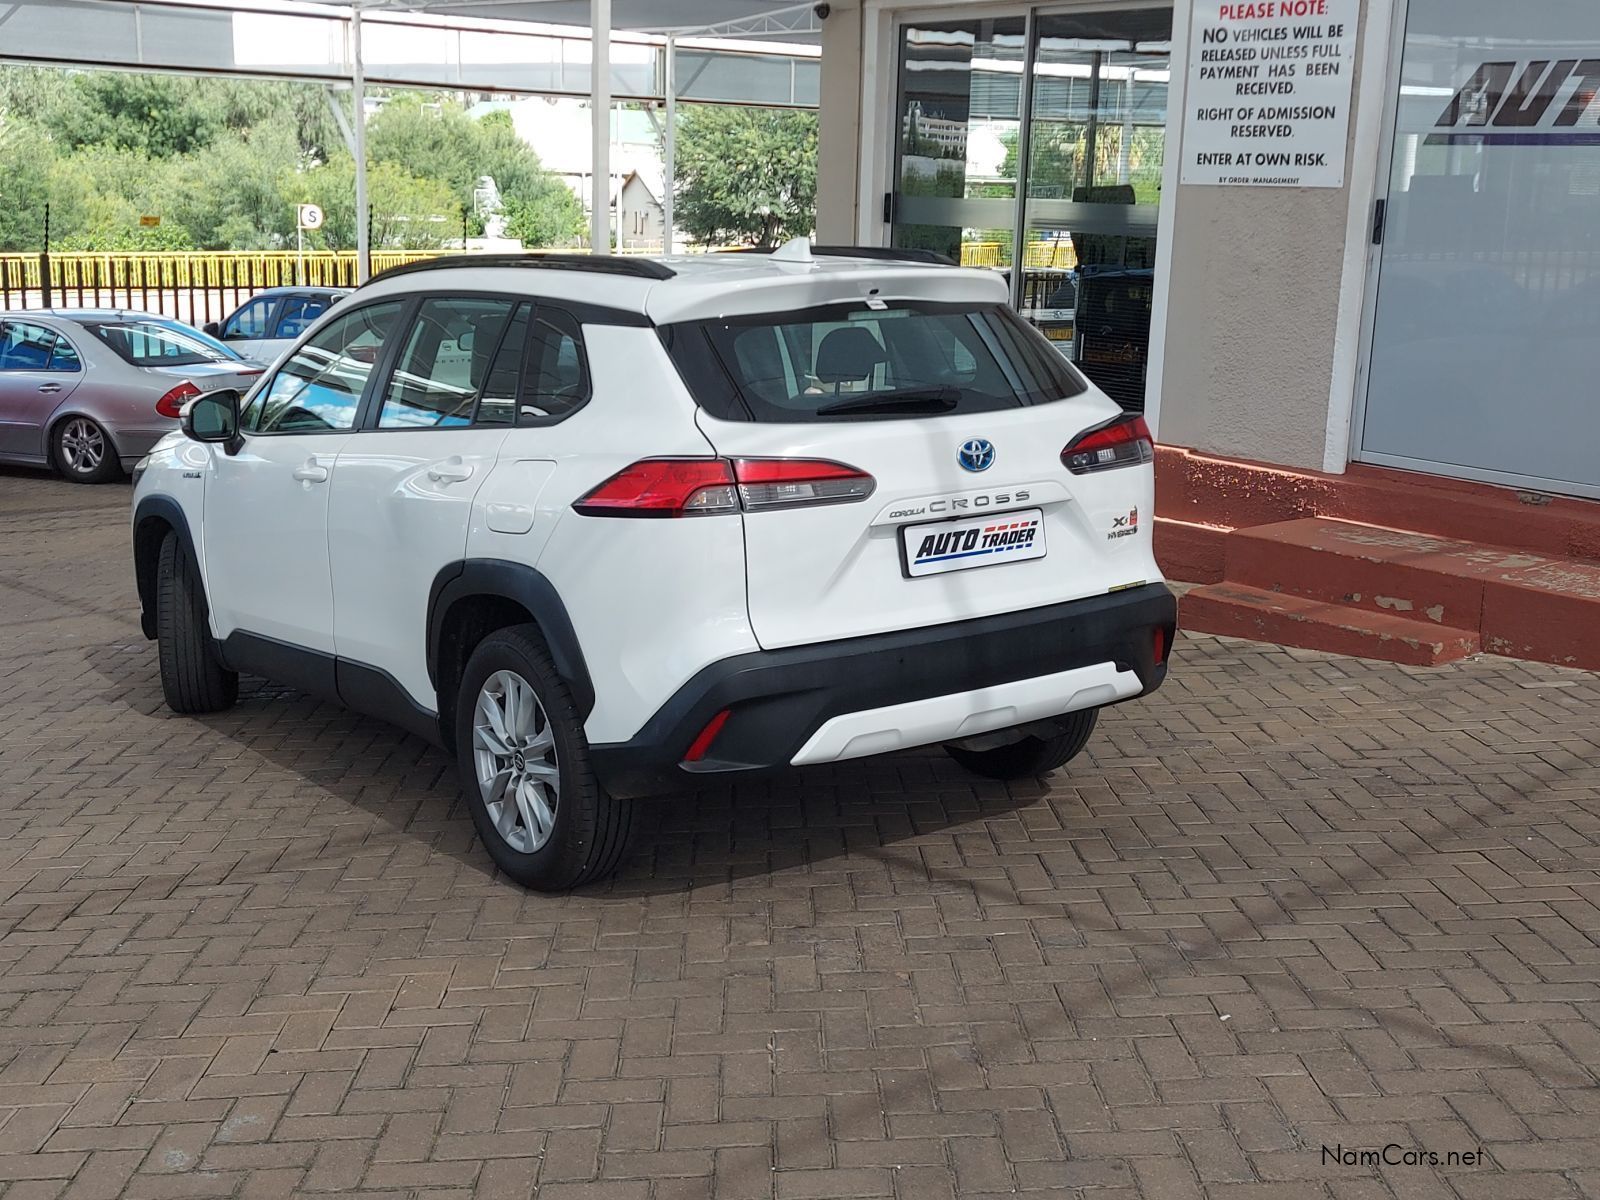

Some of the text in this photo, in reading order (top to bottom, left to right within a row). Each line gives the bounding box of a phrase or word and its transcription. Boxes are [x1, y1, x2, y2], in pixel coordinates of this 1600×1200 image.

[1219, 0, 1328, 20] PLEASE NOTE:
[1203, 24, 1344, 43] NO VEHICLES WILL BE
[1201, 44, 1341, 62] RELEASED UNLESS FULL
[1200, 63, 1339, 79] PAYMENT HAS BEEN
[1236, 82, 1296, 95] RECEIVED.
[1197, 106, 1336, 121] RIGHT OF ADMISSION
[1230, 125, 1295, 138] RESERVED.
[1197, 153, 1328, 166] ENTER AT OWN RISK.
[1228, 176, 1249, 184] ORDER
[308, 210, 317, 223] S
[889, 491, 1030, 518] COROLLA CROSS
[916, 528, 1036, 558] AUTO TRADER
